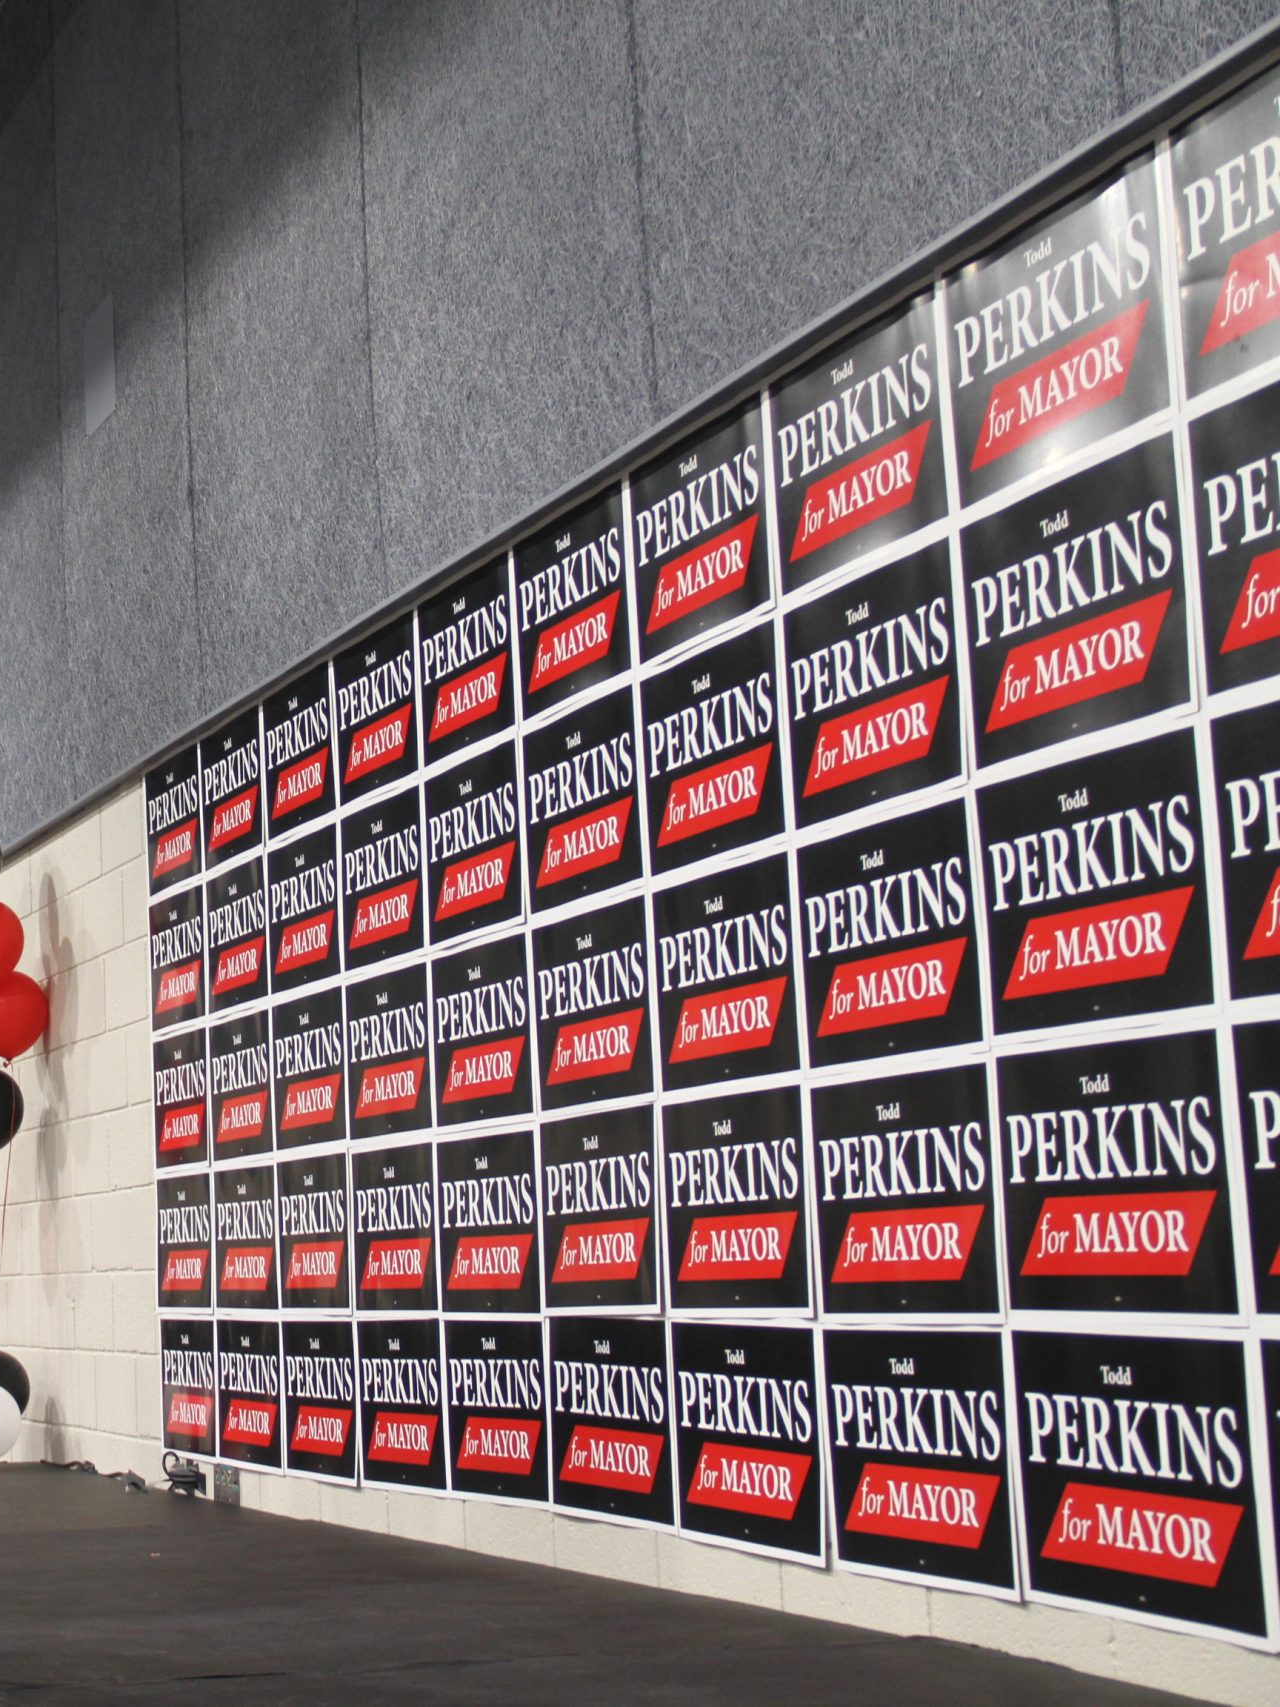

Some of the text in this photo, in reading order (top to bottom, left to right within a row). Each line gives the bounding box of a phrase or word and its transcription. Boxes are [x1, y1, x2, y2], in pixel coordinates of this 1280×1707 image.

[1023, 237, 1052, 268] Todd
[954, 211, 1150, 387] PERKINS
[1220, 270, 1261, 328] for
[830, 359, 854, 385] Todd
[985, 336, 1123, 447] for MAYOR
[778, 343, 931, 487] PERKINS
[679, 454, 698, 477] Todd
[636, 444, 759, 567] PERKINS
[802, 450, 912, 541] for MAYOR
[555, 533, 571, 553] Todd
[1040, 510, 1069, 538] Todd
[519, 527, 620, 632] PERKINS
[655, 539, 744, 616] for MAYOR
[971, 500, 1172, 647] PERKINS
[845, 601, 869, 625] Todd
[422, 594, 507, 685] PERKINS
[536, 612, 608, 678] for MAYOR
[791, 597, 949, 720] PERKINS
[691, 673, 711, 694] Todd
[1000, 621, 1144, 711] for MAYOR
[339, 650, 412, 731] PERKINS
[435, 671, 497, 728] for MAYOR
[266, 697, 328, 770] PERKINS
[350, 720, 403, 771] for MAYOR
[566, 731, 581, 749] Todd
[647, 672, 772, 778] PERKINS
[814, 702, 928, 778] for MAYOR
[204, 739, 258, 805] PERKINS
[277, 762, 322, 808] for MAYOR
[530, 732, 633, 824] PERKINS
[148, 776, 197, 835] PERKINS
[222, 799, 251, 833] MAYOR
[667, 765, 757, 830] for MAYOR
[1058, 788, 1089, 812] Todd
[165, 831, 191, 862] MAYOR
[430, 782, 515, 863] PERKINS
[545, 816, 620, 873] for MAYOR
[345, 825, 418, 895] PERKINS
[860, 849, 884, 870] Todd
[988, 795, 1194, 911] PERKINS
[271, 859, 335, 923] PERKINS
[441, 858, 504, 908] for MAYOR
[704, 896, 723, 914] Todd
[209, 891, 265, 948] PERKINS
[355, 894, 409, 937] for MAYOR
[805, 857, 966, 958] PERKINS
[152, 916, 201, 969] PERKINS
[227, 949, 257, 979] MAYOR
[280, 923, 327, 963] for MAYOR
[576, 934, 592, 950] Todd
[659, 904, 787, 992] PERKINS
[1019, 912, 1166, 981] for MAYOR
[168, 971, 195, 999] MAYOR
[538, 943, 644, 1020] PERKINS
[829, 959, 946, 1020] for MAYOR
[349, 1002, 425, 1063] PERKINS
[436, 976, 526, 1044] PERKINS
[679, 996, 771, 1048] for MAYOR
[213, 1043, 268, 1094] PERKINS
[275, 1023, 341, 1078] PERKINS
[449, 1051, 513, 1091] for MAYOR
[555, 1025, 631, 1071] for MAYOR
[157, 1059, 205, 1106] PERKINS
[285, 1086, 333, 1119] for MAYOR
[361, 1070, 416, 1107] for MAYOR
[1079, 1073, 1110, 1094] Todd
[172, 1114, 199, 1138] MAYOR
[231, 1102, 261, 1128] MAYOR
[712, 1119, 732, 1136] Todd
[876, 1102, 900, 1121] Todd
[582, 1135, 599, 1151] Todd
[819, 1122, 985, 1201] PERKINS
[1006, 1096, 1216, 1184] PERKINS
[545, 1151, 650, 1216] PERKINS
[669, 1137, 798, 1207] PERKINS
[159, 1204, 210, 1244] PERKINS
[217, 1199, 273, 1240] PERKINS
[280, 1189, 344, 1236] PERKINS
[356, 1182, 431, 1233] PERKINS
[442, 1173, 533, 1228] PERKINS
[560, 1232, 636, 1270] for MAYOR
[688, 1227, 781, 1267] for MAYOR
[843, 1222, 962, 1267] for MAYOR
[1037, 1210, 1189, 1258] for MAYOR
[173, 1258, 202, 1279] MAYOR
[234, 1256, 266, 1278] MAYOR
[291, 1251, 336, 1278] for MAYOR
[367, 1249, 422, 1279] for MAYOR
[455, 1246, 520, 1278] for MAYOR
[164, 1350, 213, 1390] PERKINS
[594, 1340, 610, 1354] Todd
[725, 1349, 745, 1365] Todd
[889, 1358, 914, 1375] Todd
[220, 1352, 278, 1396] PERKINS
[287, 1356, 353, 1401] PERKINS
[361, 1358, 438, 1406] PERKINS
[449, 1358, 541, 1410] PERKINS
[554, 1361, 664, 1424] PERKINS
[1100, 1365, 1132, 1386] Todd
[179, 1402, 207, 1426] MAYOR
[238, 1409, 270, 1434] MAYOR
[296, 1414, 343, 1443] for MAYOR
[678, 1371, 811, 1443] PERKINS
[831, 1384, 1001, 1461] PERKINS
[374, 1421, 429, 1451] for MAYOR
[464, 1427, 530, 1459] for MAYOR
[568, 1436, 651, 1477] for MAYOR
[1024, 1392, 1242, 1488] PERKINS
[697, 1454, 793, 1501] for MAYOR
[858, 1477, 979, 1528] for MAYOR
[1058, 1498, 1216, 1563] for MAYOR
